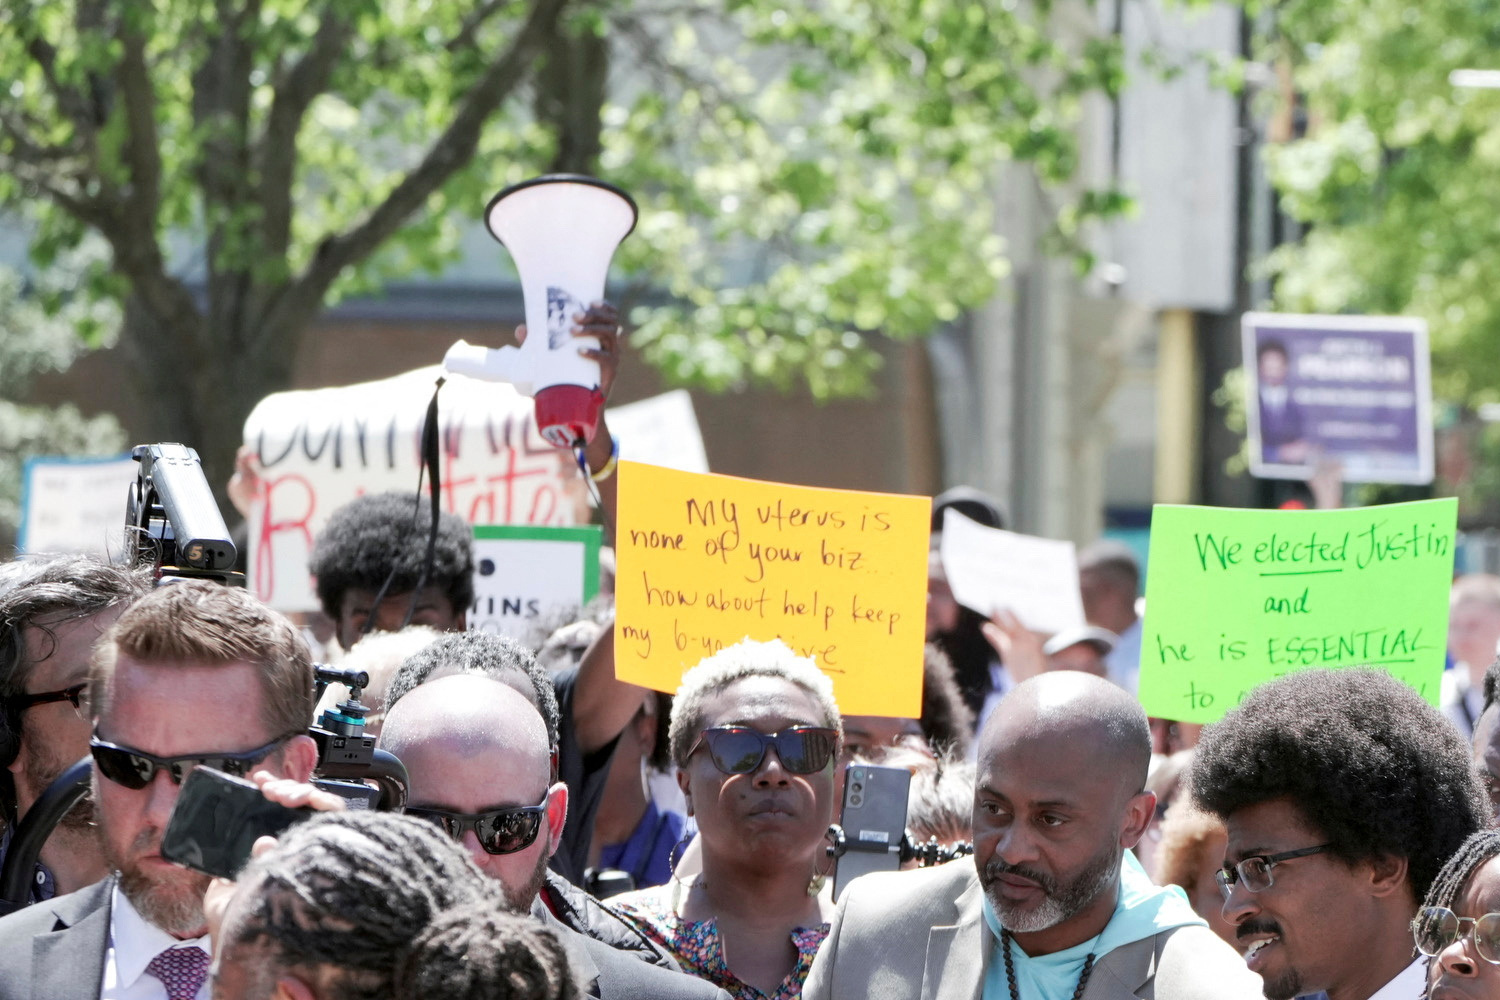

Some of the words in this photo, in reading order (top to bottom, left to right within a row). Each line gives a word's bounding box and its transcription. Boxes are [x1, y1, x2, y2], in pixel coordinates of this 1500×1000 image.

[686, 498, 739, 548] My
[757, 499, 846, 532] uterus
[861, 506, 891, 532] is
[1193, 532, 1243, 572] We
[1253, 531, 1350, 566] elected
[1355, 519, 1449, 570] Justin
[630, 529, 687, 551] none
[705, 530, 738, 564] of
[744, 542, 803, 583] your
[643, 571, 698, 607] how
[706, 588, 772, 619] about
[783, 589, 835, 631] help
[852, 594, 901, 635] keep
[1263, 586, 1312, 616] and
[622, 625, 651, 660] my
[1156, 633, 1196, 665] he
[1219, 633, 1248, 661] is
[1266, 627, 1438, 667] ESSENTIAL
[1183, 681, 1215, 710] to
